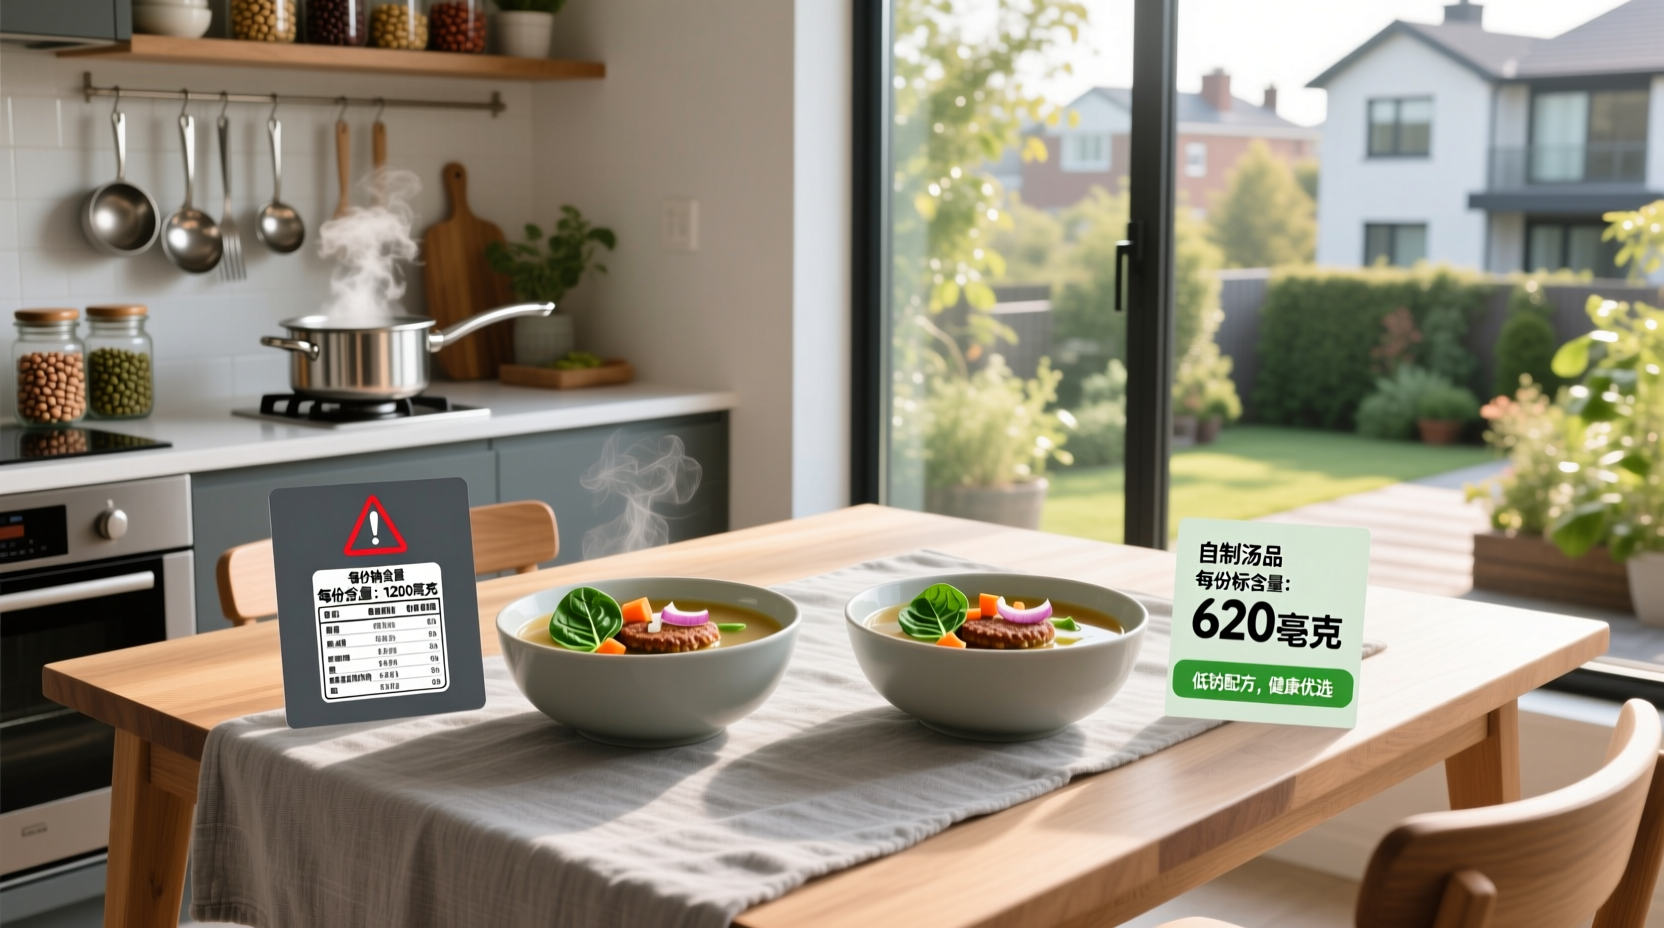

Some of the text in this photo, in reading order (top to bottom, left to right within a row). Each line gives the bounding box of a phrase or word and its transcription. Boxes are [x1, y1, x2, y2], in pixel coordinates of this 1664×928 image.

[1199, 541, 1283, 567] 自制汤品
[1192, 598, 1343, 650] 620毫克
